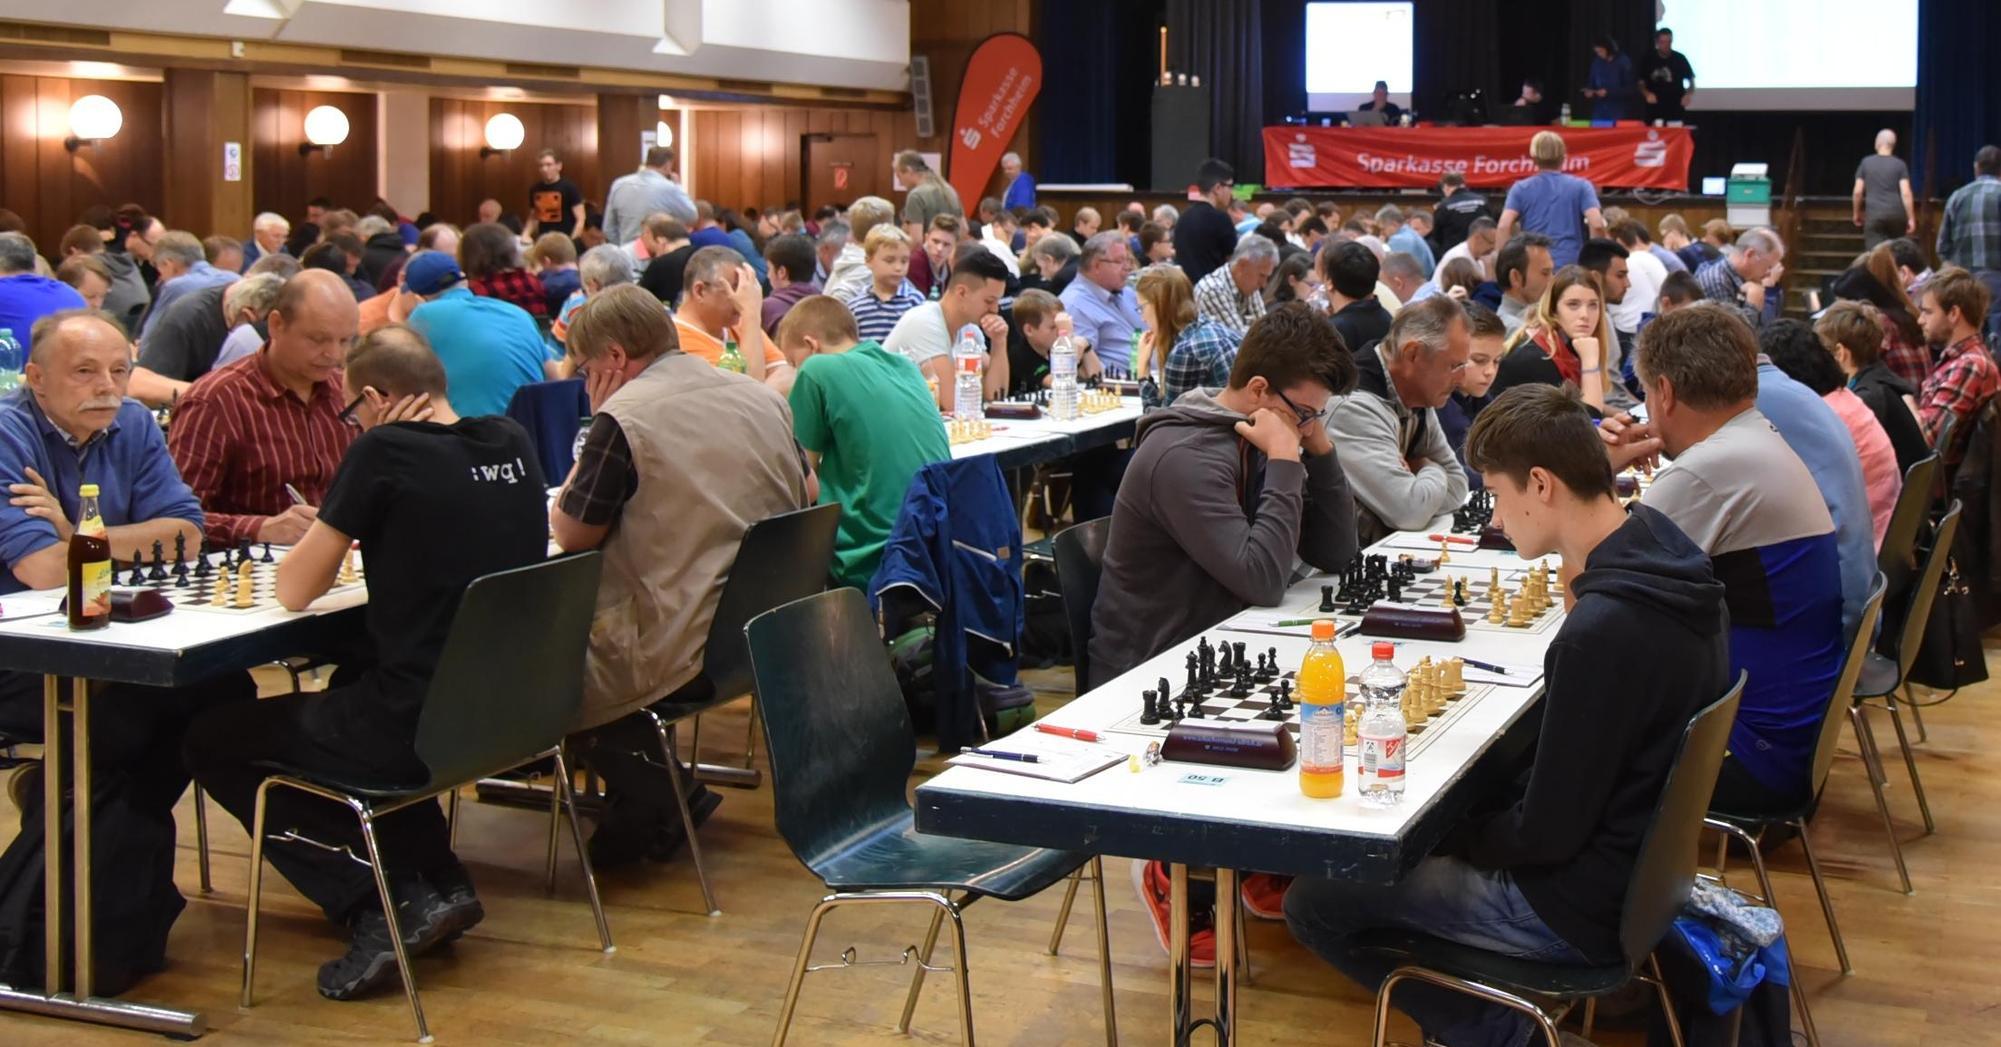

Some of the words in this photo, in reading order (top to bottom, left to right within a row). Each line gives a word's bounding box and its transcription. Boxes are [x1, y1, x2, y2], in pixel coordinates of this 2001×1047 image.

[978, 66, 1019, 129] Sparkasse
[1356, 152, 1469, 174] Sparkasse
[1472, 153, 1590, 174] Forchim
[471, 457, 526, 484] :wq!
